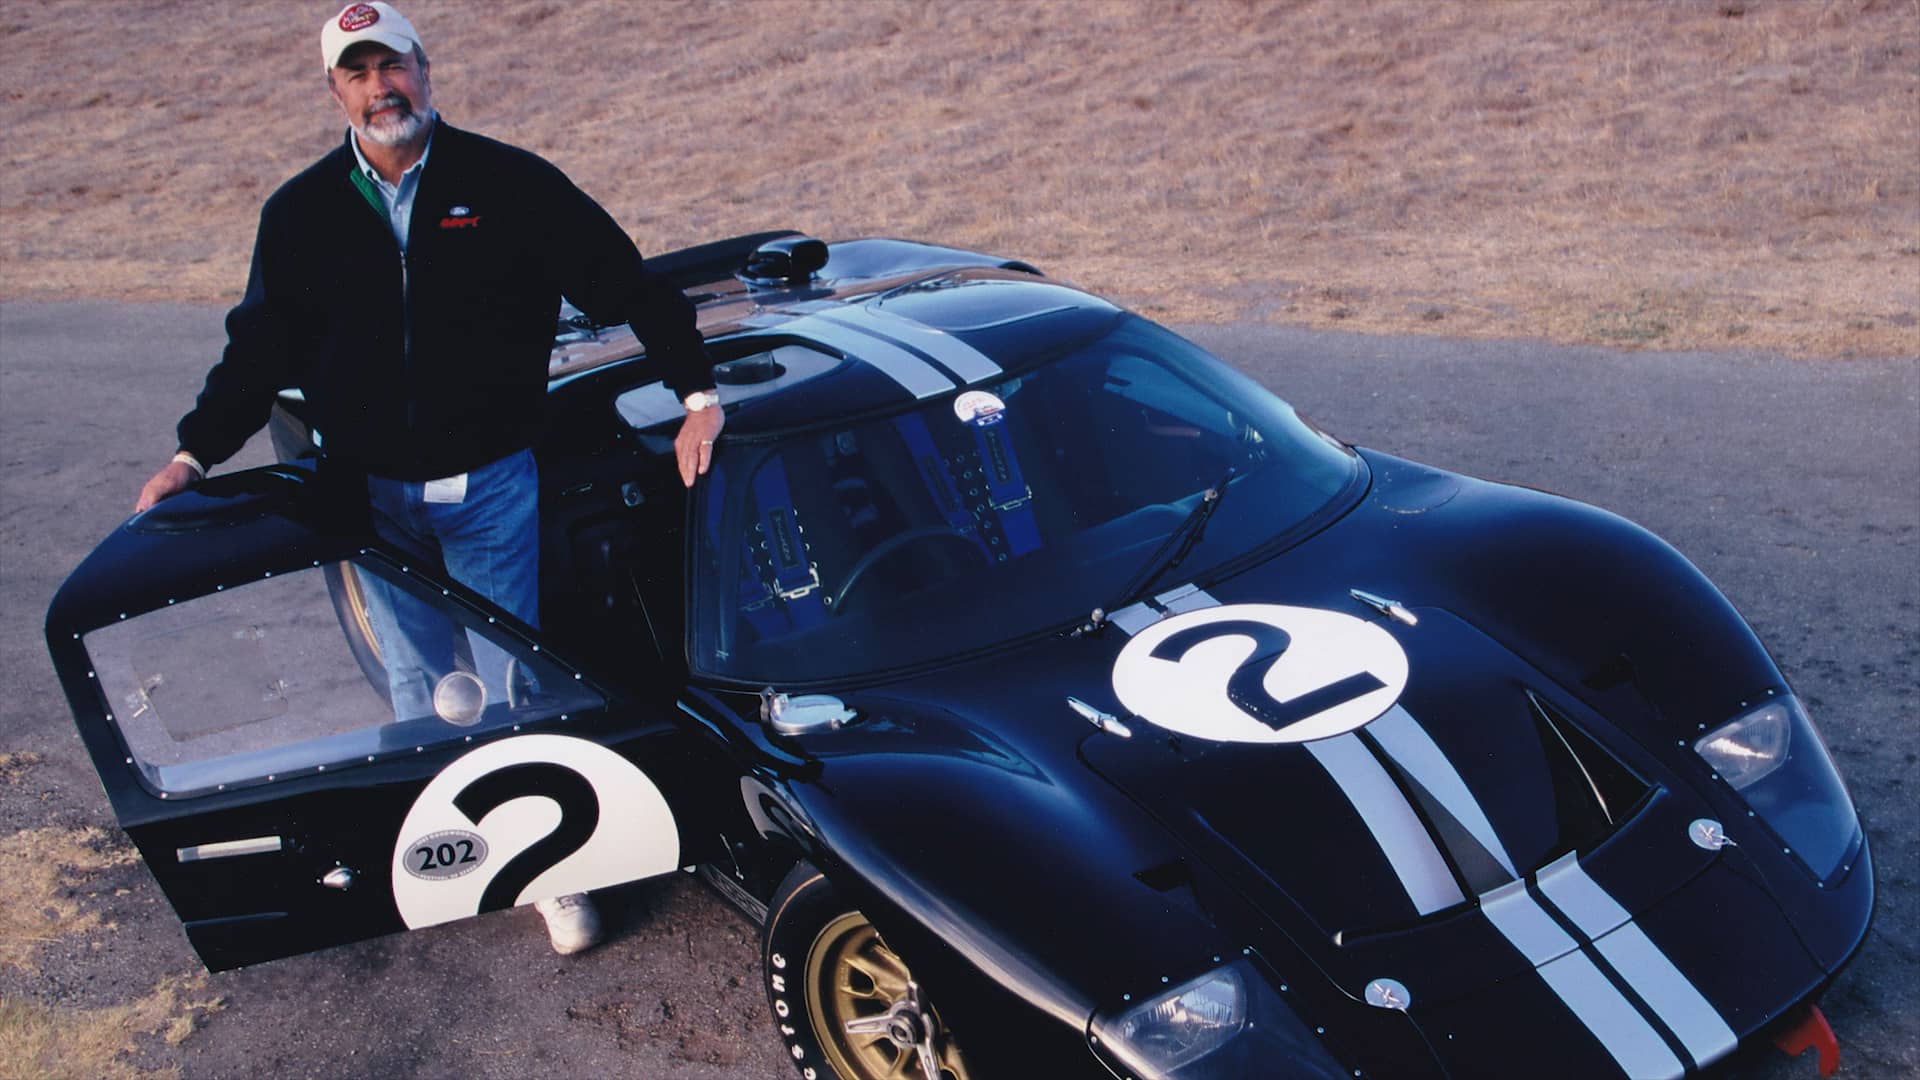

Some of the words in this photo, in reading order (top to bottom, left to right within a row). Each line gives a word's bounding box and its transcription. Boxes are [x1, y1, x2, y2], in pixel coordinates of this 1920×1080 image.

[1149, 620, 1389, 731] 2
[415, 839, 477, 871] 202
[452, 762, 600, 915] 2
